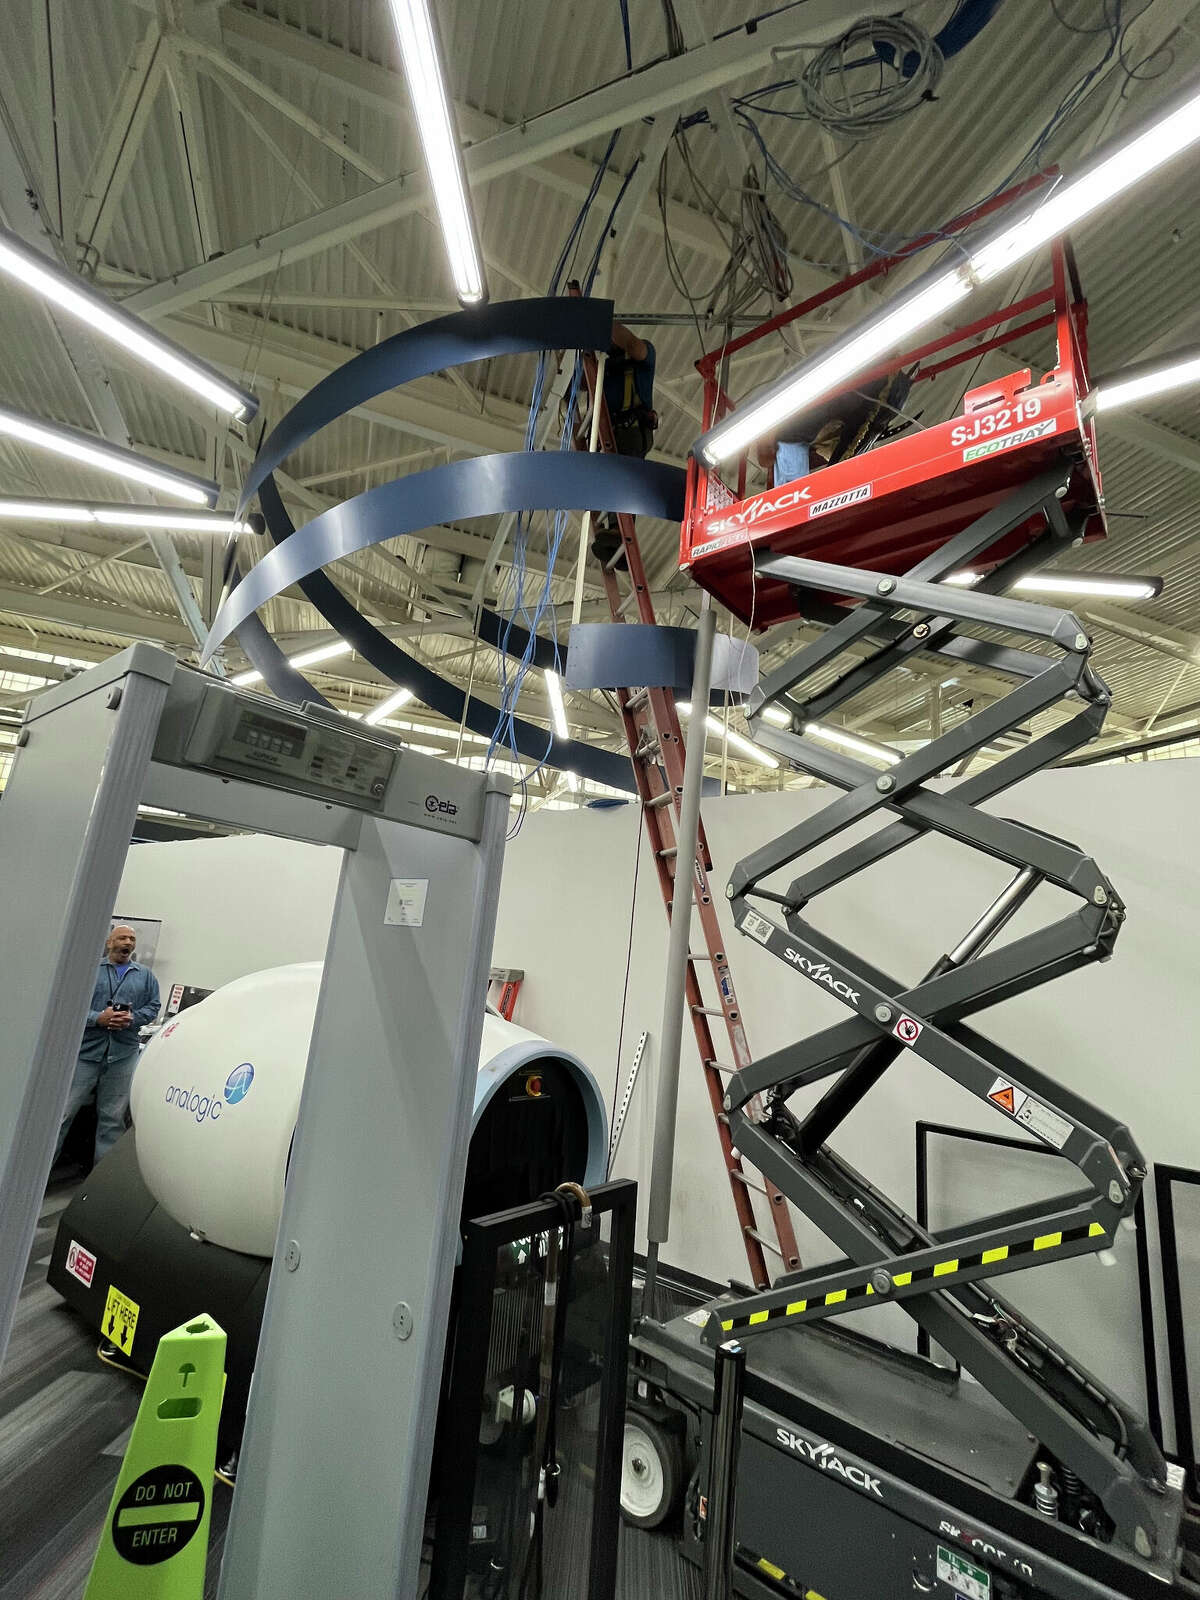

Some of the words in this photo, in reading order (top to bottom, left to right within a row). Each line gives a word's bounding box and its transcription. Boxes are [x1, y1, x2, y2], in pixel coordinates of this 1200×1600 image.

[951, 398, 1042, 446] SJ3219
[965, 419, 1054, 461] ECOTRAY
[706, 486, 813, 536] SKYJACK
[812, 486, 868, 515] MAZZOTTA
[783, 947, 861, 1005] SKYJACK
[165, 1086, 222, 1123] analogic
[119, 1303, 137, 1330] HERE
[776, 1428, 884, 1498] SKYJACK
[135, 1485, 157, 1502] DO
[163, 1481, 194, 1500] NOT
[132, 1527, 178, 1548] ENTER
